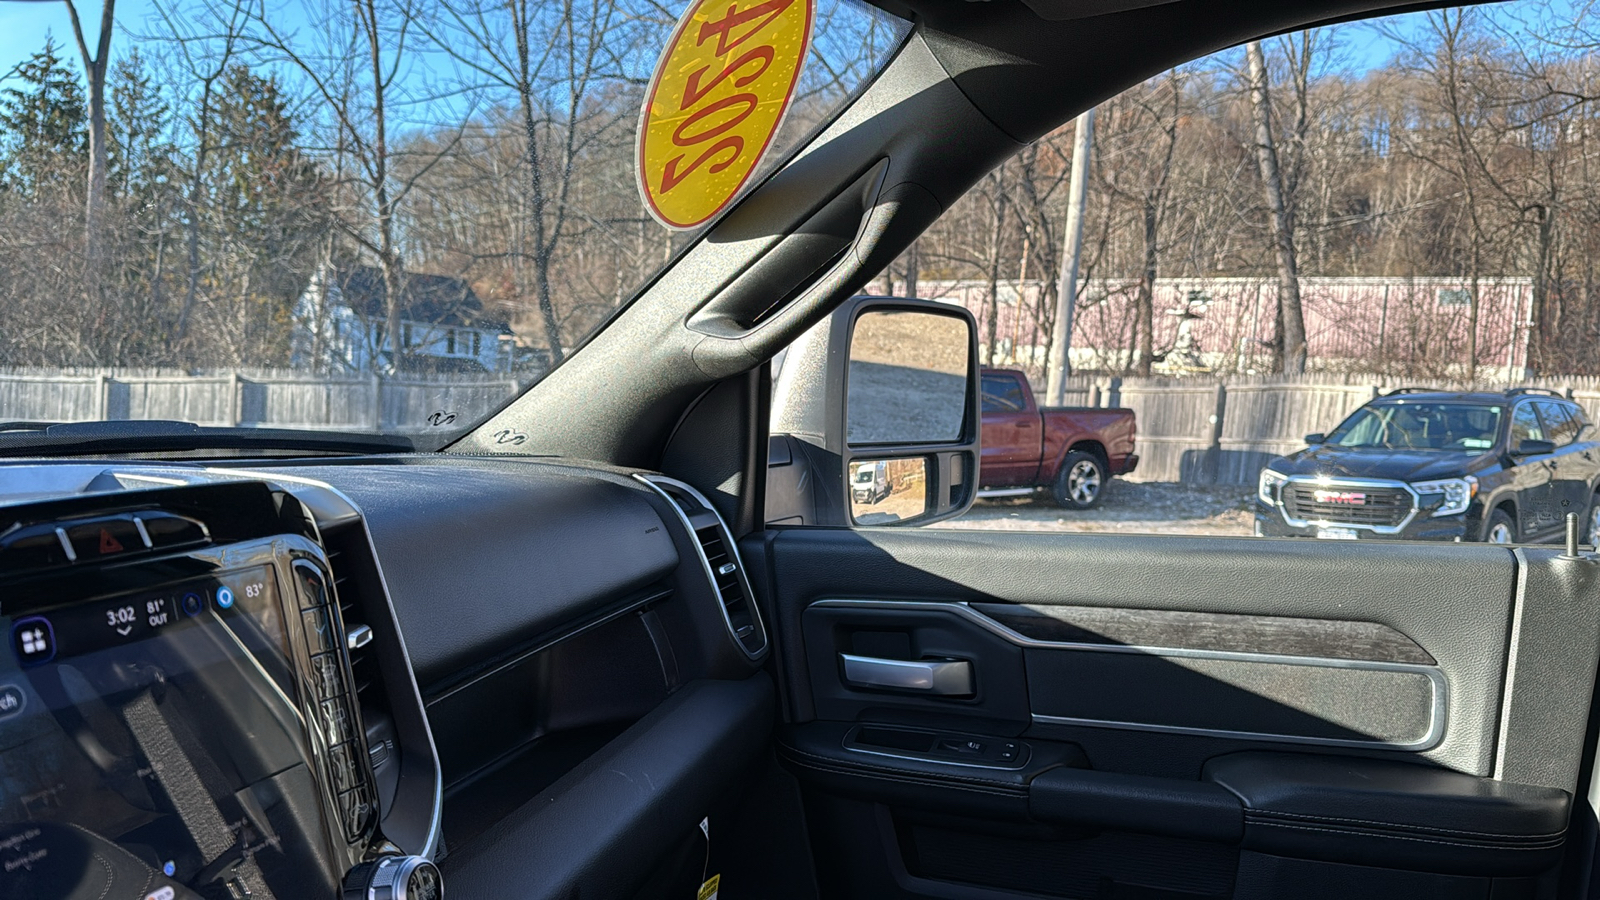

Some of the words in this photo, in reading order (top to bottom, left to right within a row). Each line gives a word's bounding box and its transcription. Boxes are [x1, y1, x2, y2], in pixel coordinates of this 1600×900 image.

[1314, 490, 1366, 505] GMC
[106, 606, 136, 626] 3:02
[149, 612, 168, 627] OUT
